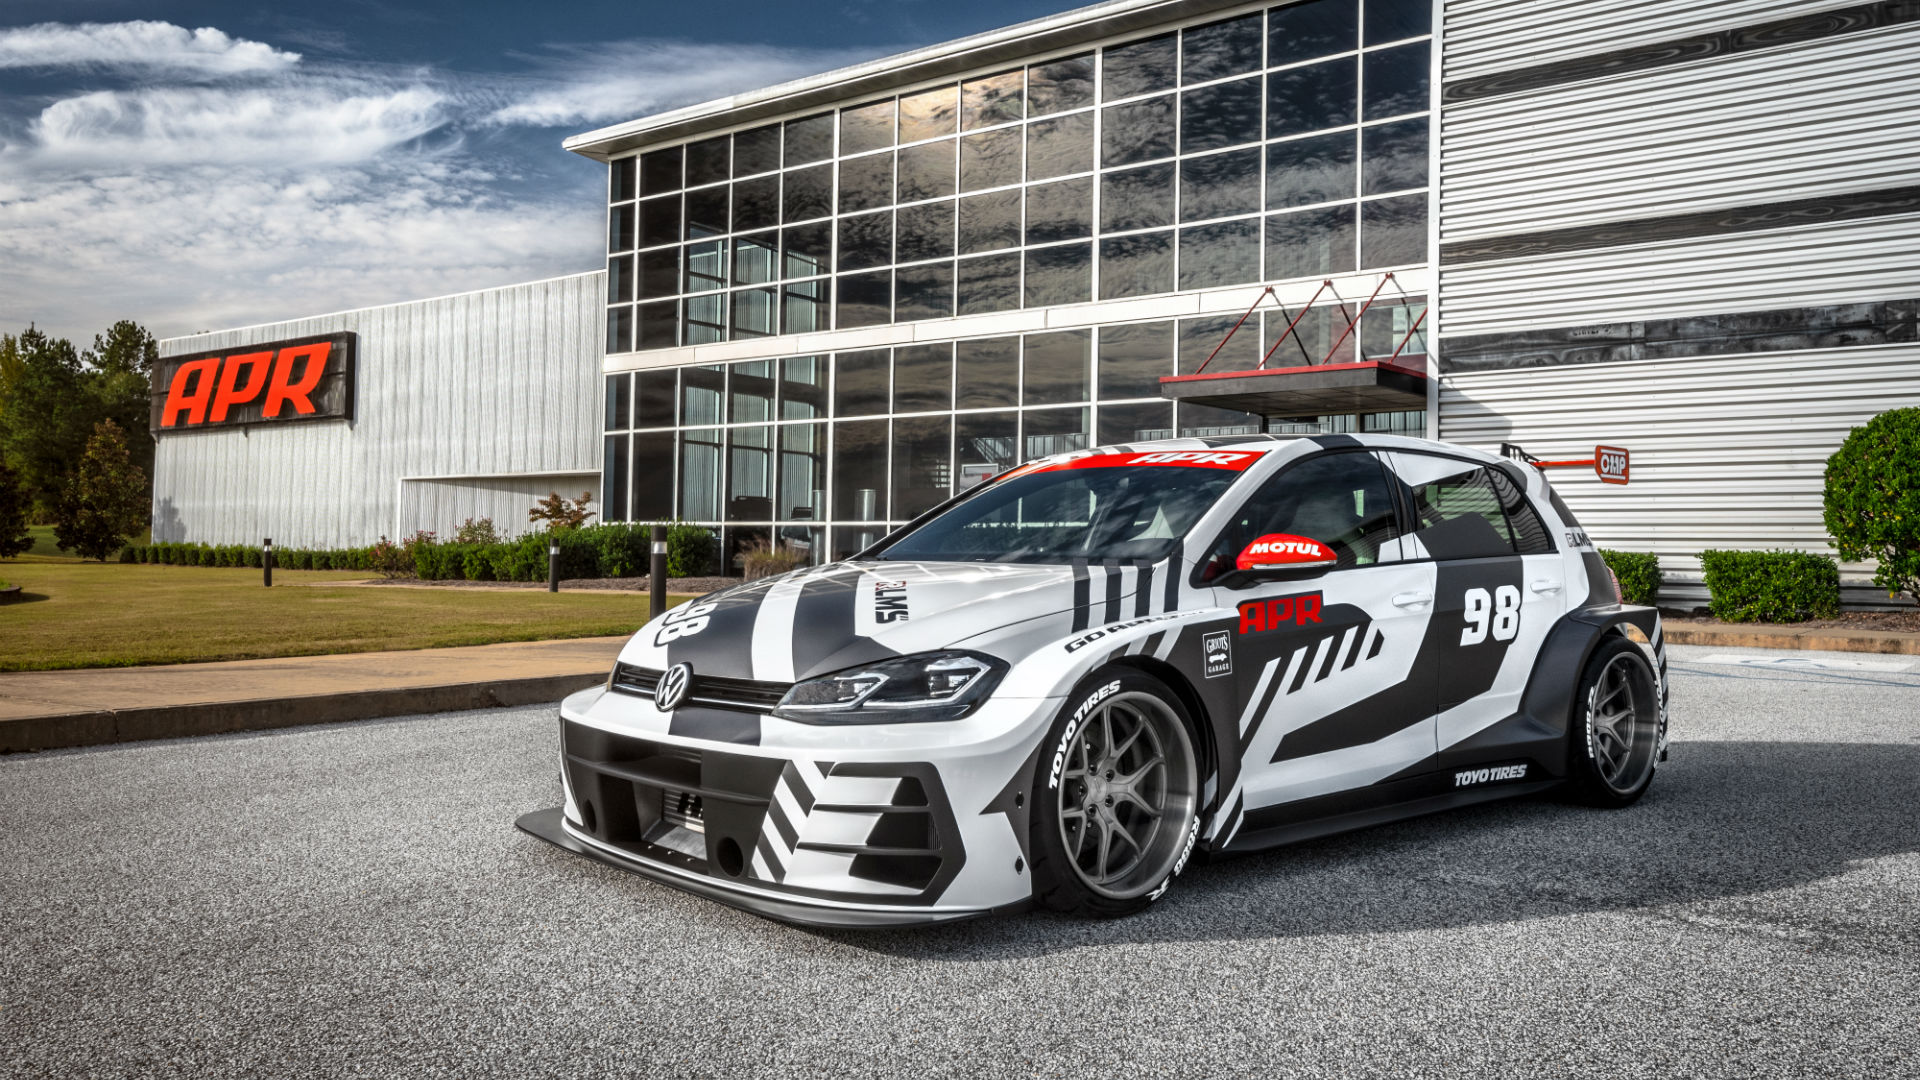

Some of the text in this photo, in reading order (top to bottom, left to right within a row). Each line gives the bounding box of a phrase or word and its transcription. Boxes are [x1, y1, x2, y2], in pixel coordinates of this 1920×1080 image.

[161, 342, 332, 427] APR
[1126, 452, 1251, 465] APR
[1601, 454, 1626, 475] OMP
[1249, 542, 1322, 557] MOTUL
[655, 603, 718, 646] 98
[1239, 594, 1323, 635] APR
[1460, 585, 1521, 647] 98
